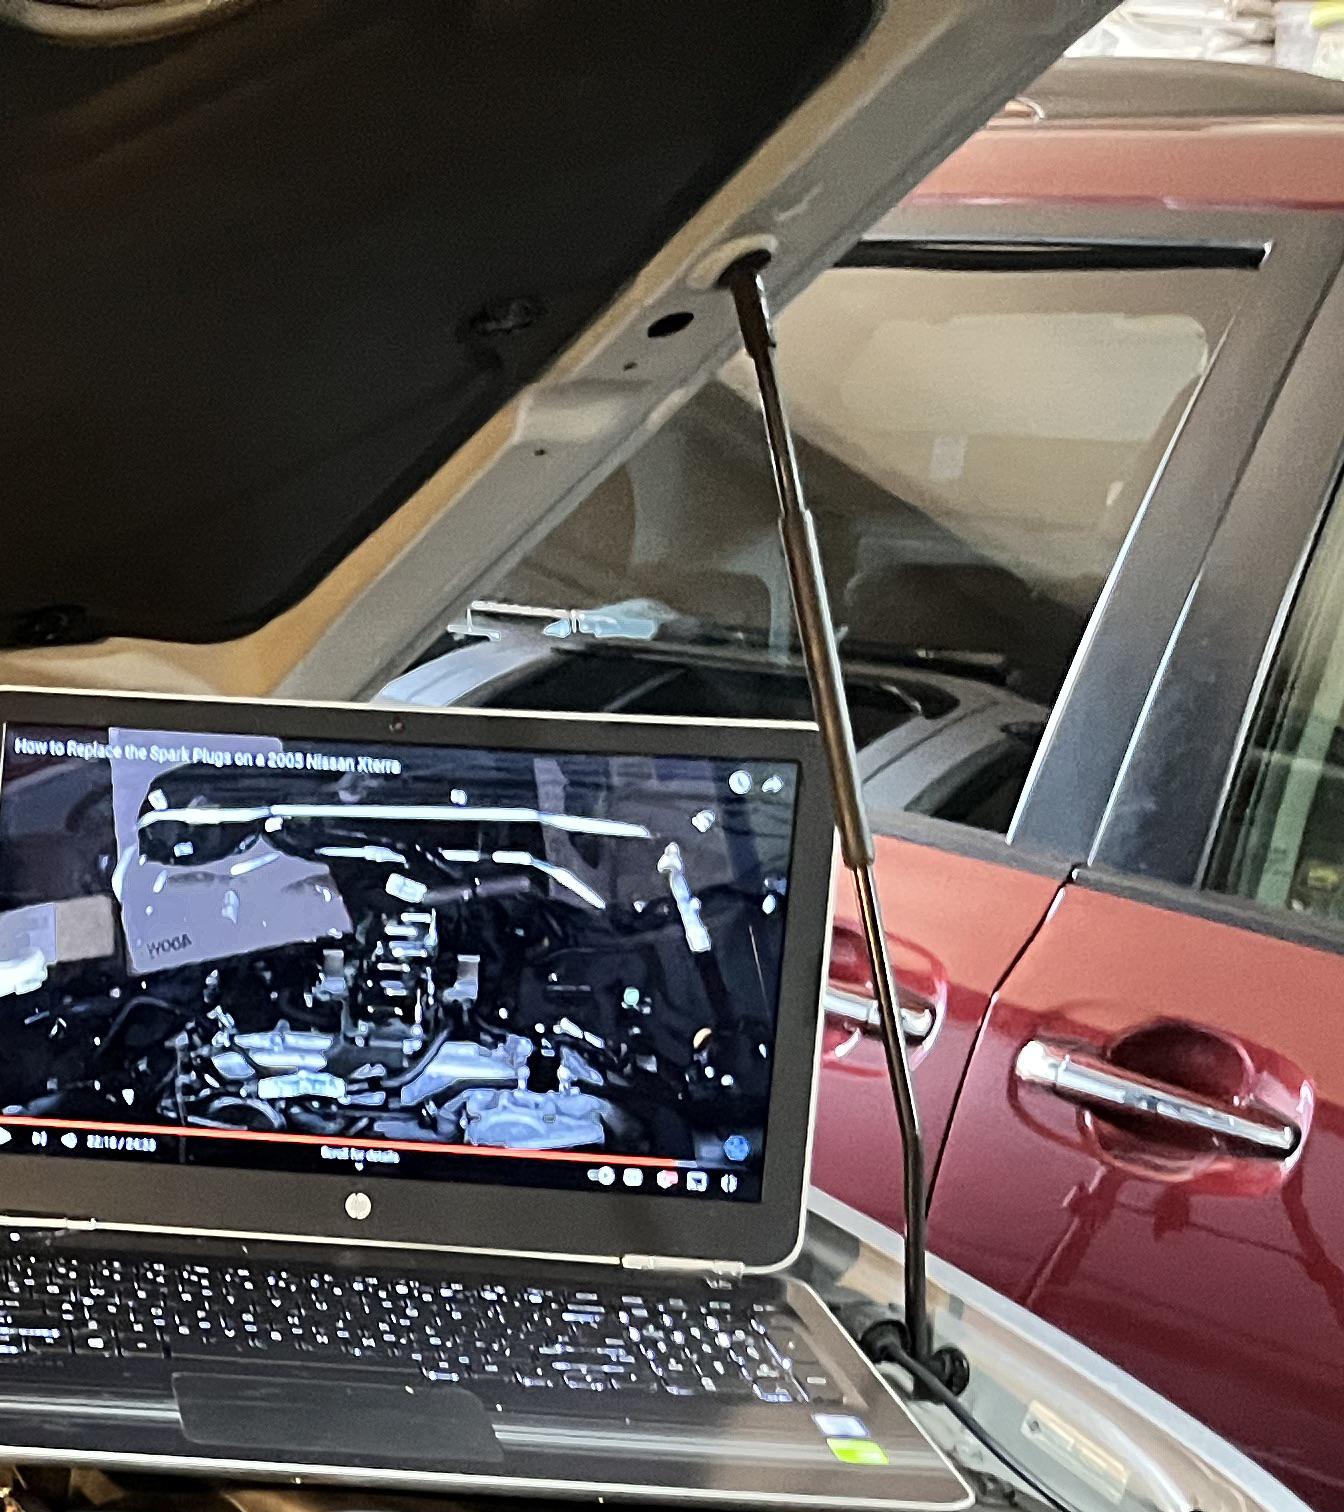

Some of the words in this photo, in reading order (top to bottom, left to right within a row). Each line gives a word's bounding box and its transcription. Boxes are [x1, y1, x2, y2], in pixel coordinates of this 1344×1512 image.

[14, 737, 48, 755] How
[49, 739, 65, 756] to
[66, 739, 122, 760] Replace
[125, 744, 147, 760] the
[149, 745, 191, 763] Spark
[192, 747, 232, 768] Plugs
[234, 751, 253, 767] on
[255, 753, 265, 768] a
[306, 752, 355, 772] Nissan
[357, 756, 402, 775] Xterra
